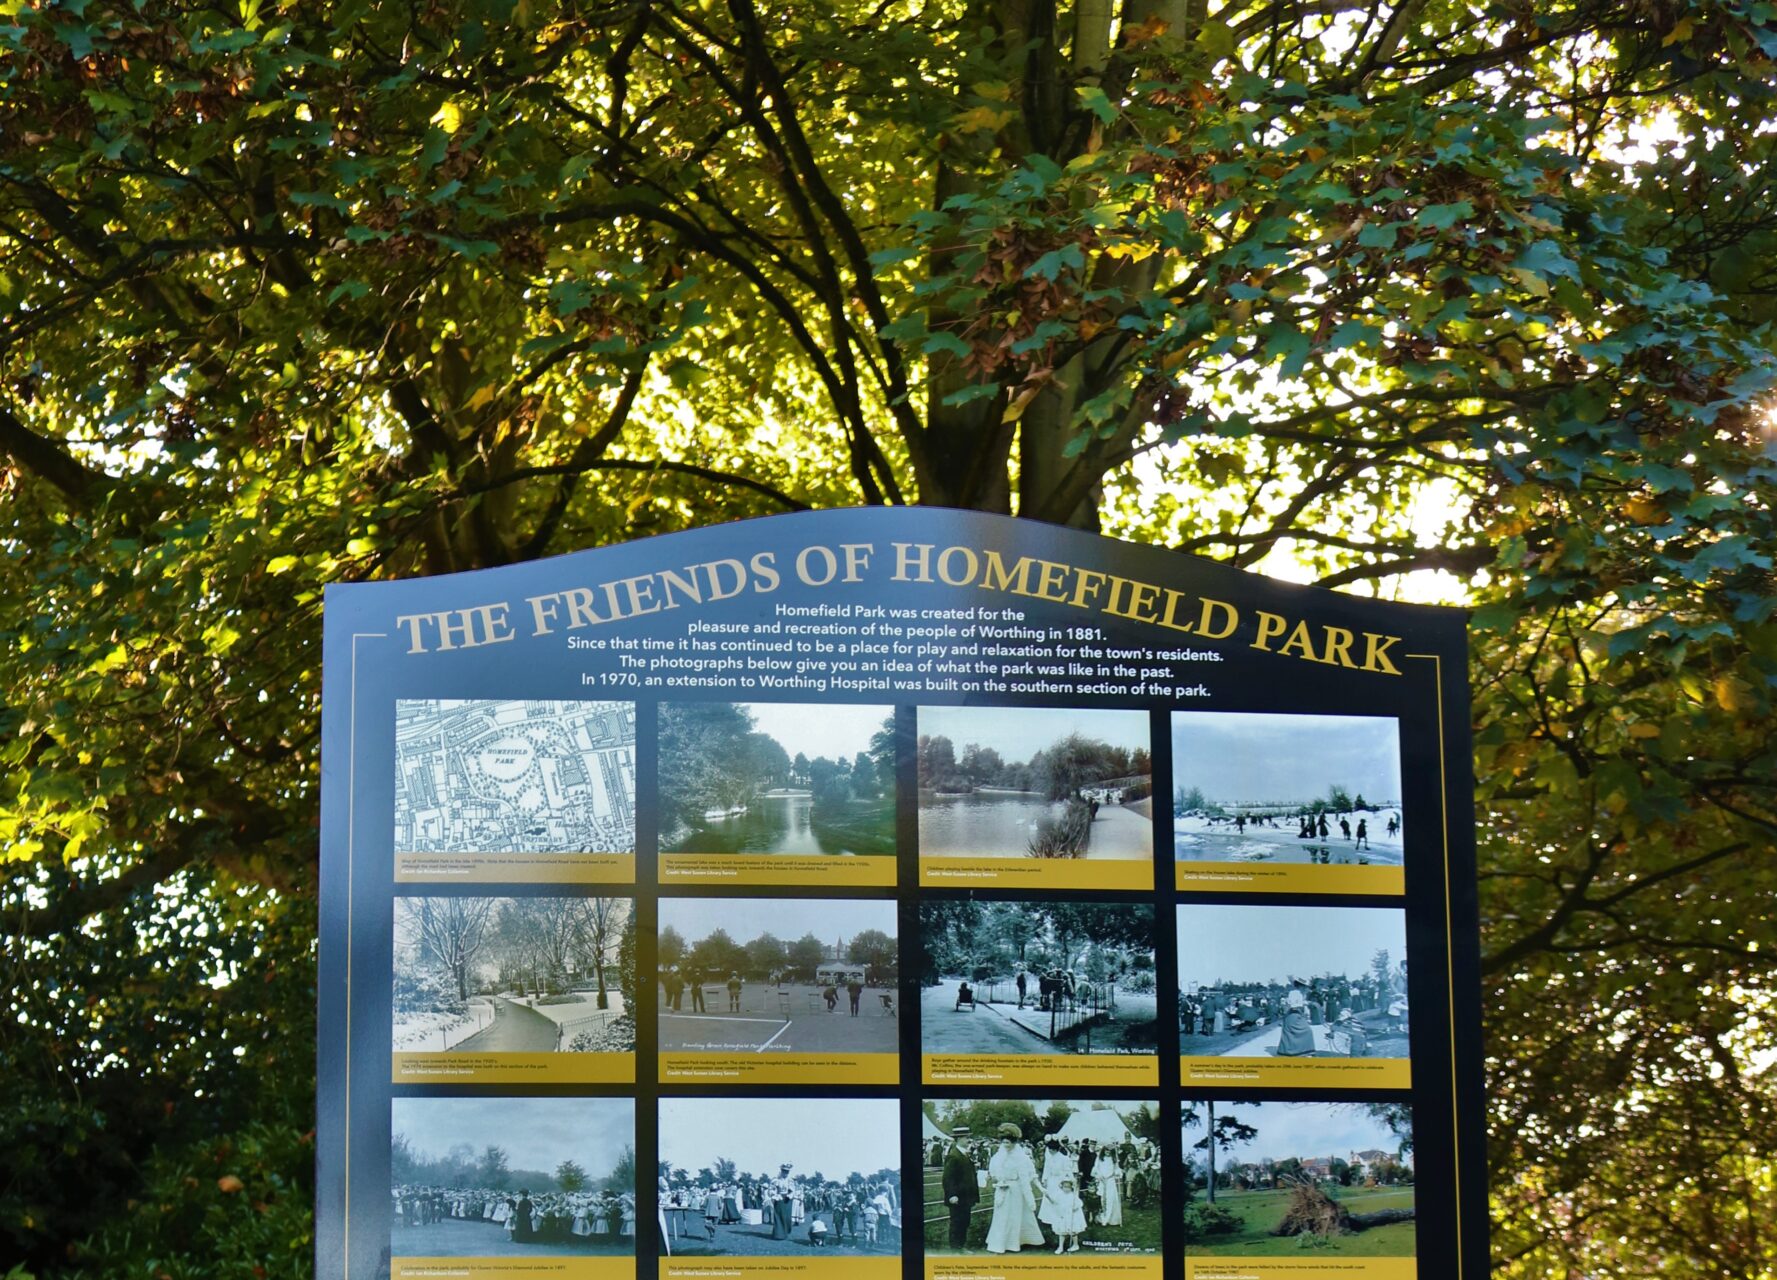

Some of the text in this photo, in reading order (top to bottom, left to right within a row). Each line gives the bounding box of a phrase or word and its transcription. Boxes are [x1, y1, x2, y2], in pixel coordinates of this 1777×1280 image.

[397, 542, 1402, 676] THE FRIENDS OF HOMEFIELD PARK
[775, 603, 1024, 621] Homefield Park was created for the
[688, 619, 1106, 642] pleasure and recreation of the people of Worthing in 1881.
[567, 636, 1223, 661] Since that time it has continued to be a place for play and relaxation for the town's residents.
[619, 654, 1174, 680] The photographs below give you an idea of what the park was like in the past.
[582, 672, 1210, 699] In 1970, an extension to Worthing Hospital was built on the southern section of the park.
